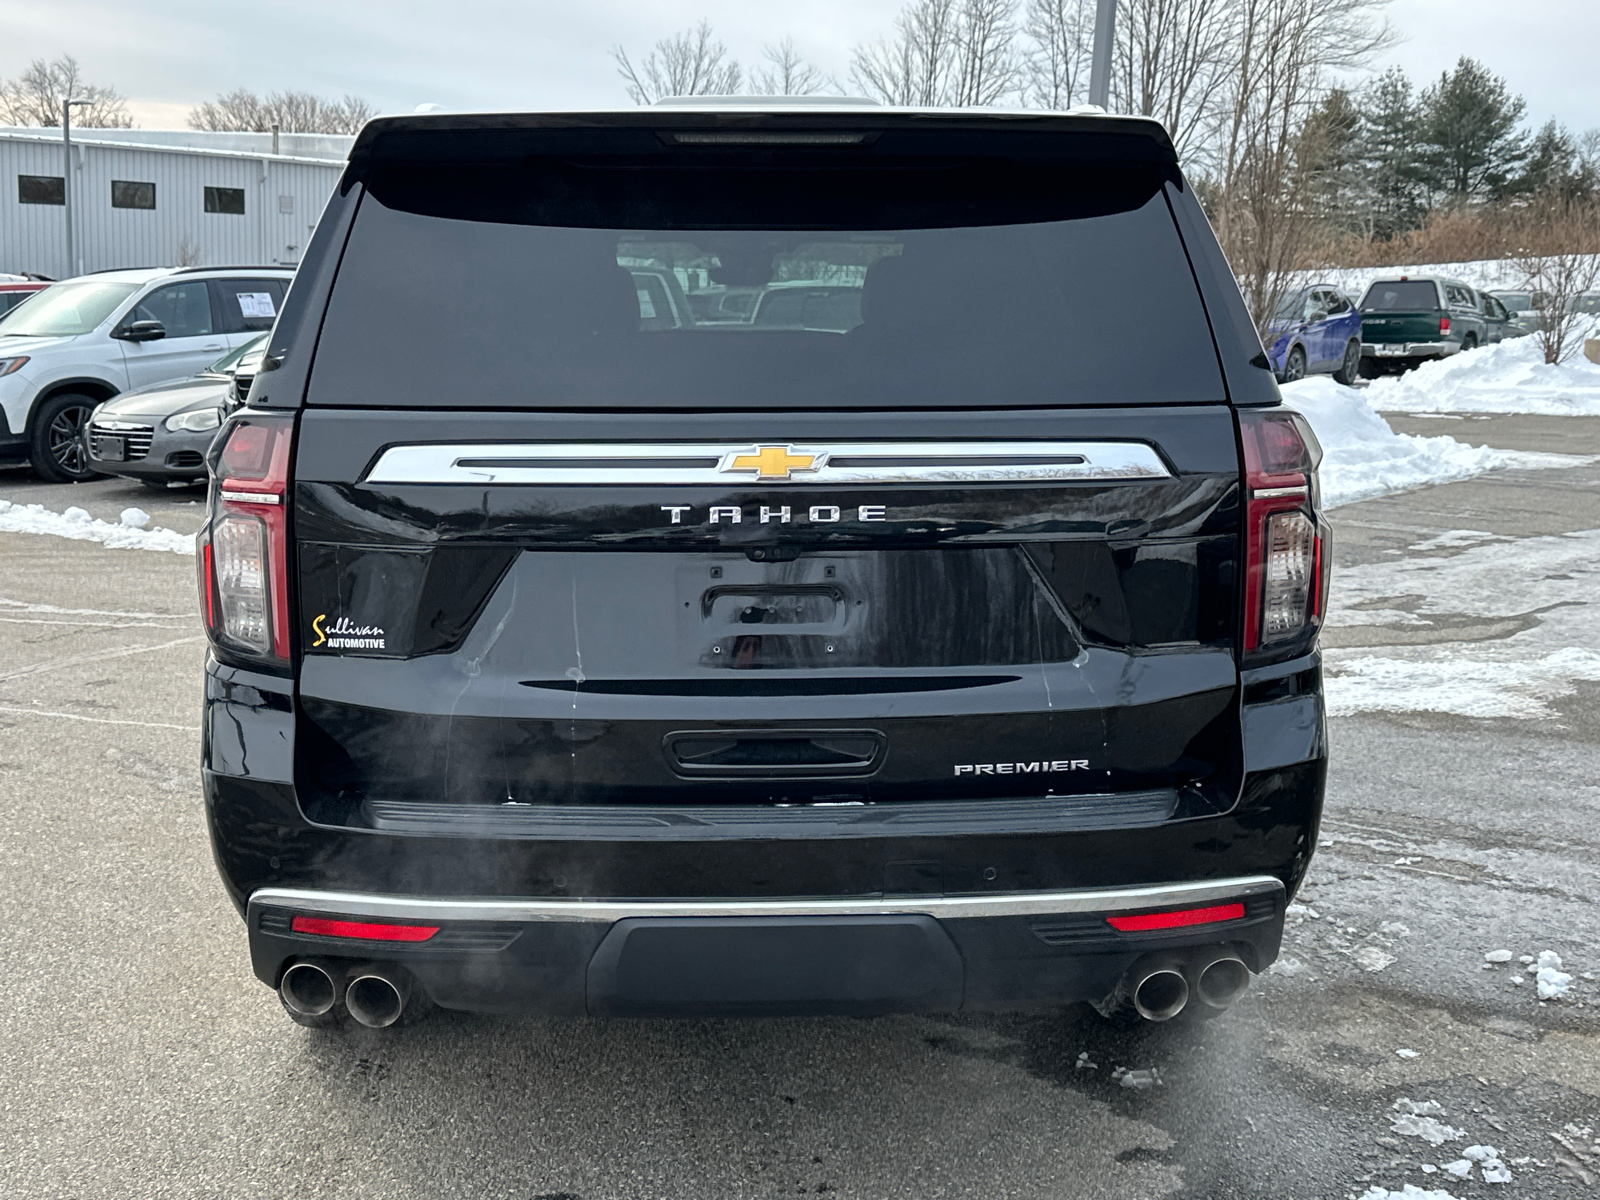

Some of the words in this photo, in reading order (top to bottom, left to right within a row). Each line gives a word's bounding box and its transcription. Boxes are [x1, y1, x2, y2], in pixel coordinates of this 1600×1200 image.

[660, 505, 886, 524] TAHOE
[312, 614, 384, 647] Sullivan
[327, 638, 386, 648] AUTOMOTIVE
[954, 759, 1090, 776] PREMIER
